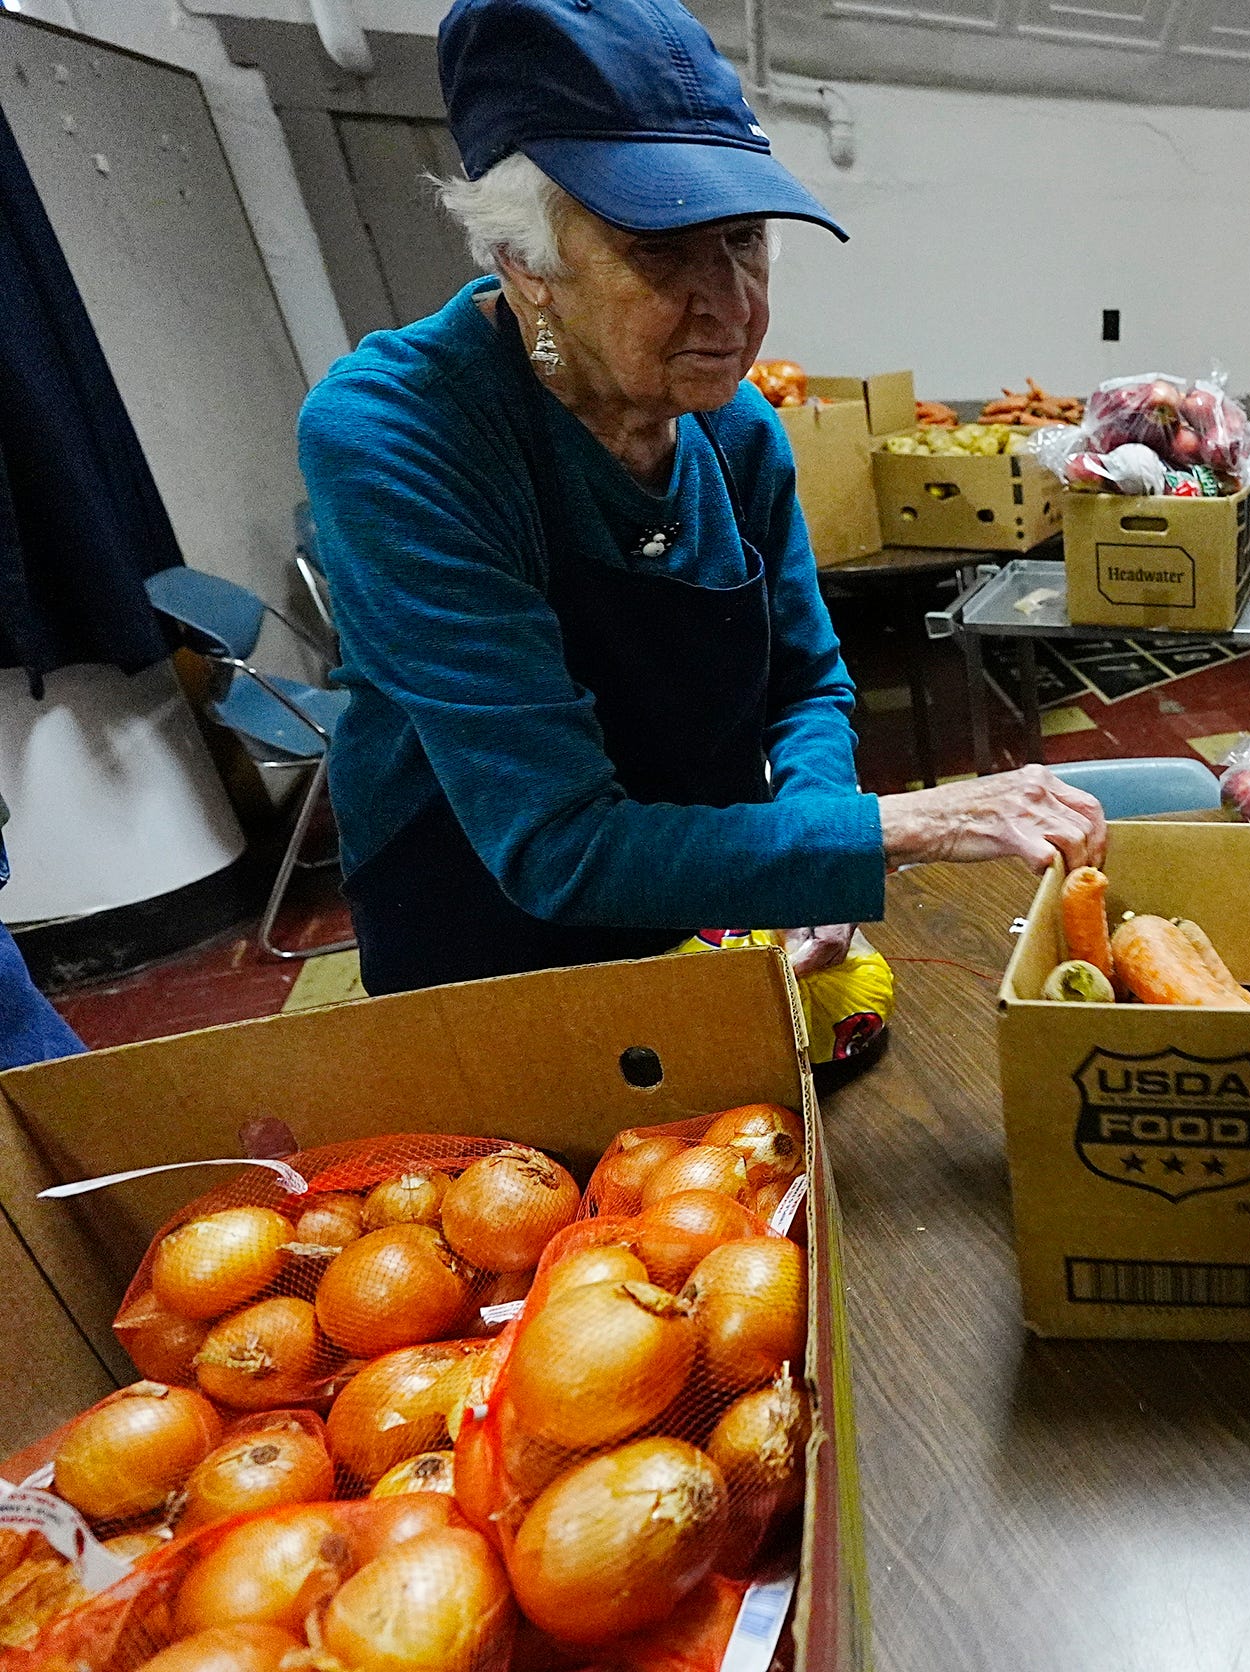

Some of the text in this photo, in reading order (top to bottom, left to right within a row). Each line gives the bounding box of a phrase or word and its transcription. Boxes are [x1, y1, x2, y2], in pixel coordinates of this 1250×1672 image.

[1108, 566, 1186, 585] Headwater
[1098, 1067, 1250, 1098] USDA
[1100, 1113, 1250, 1144] FOOD
